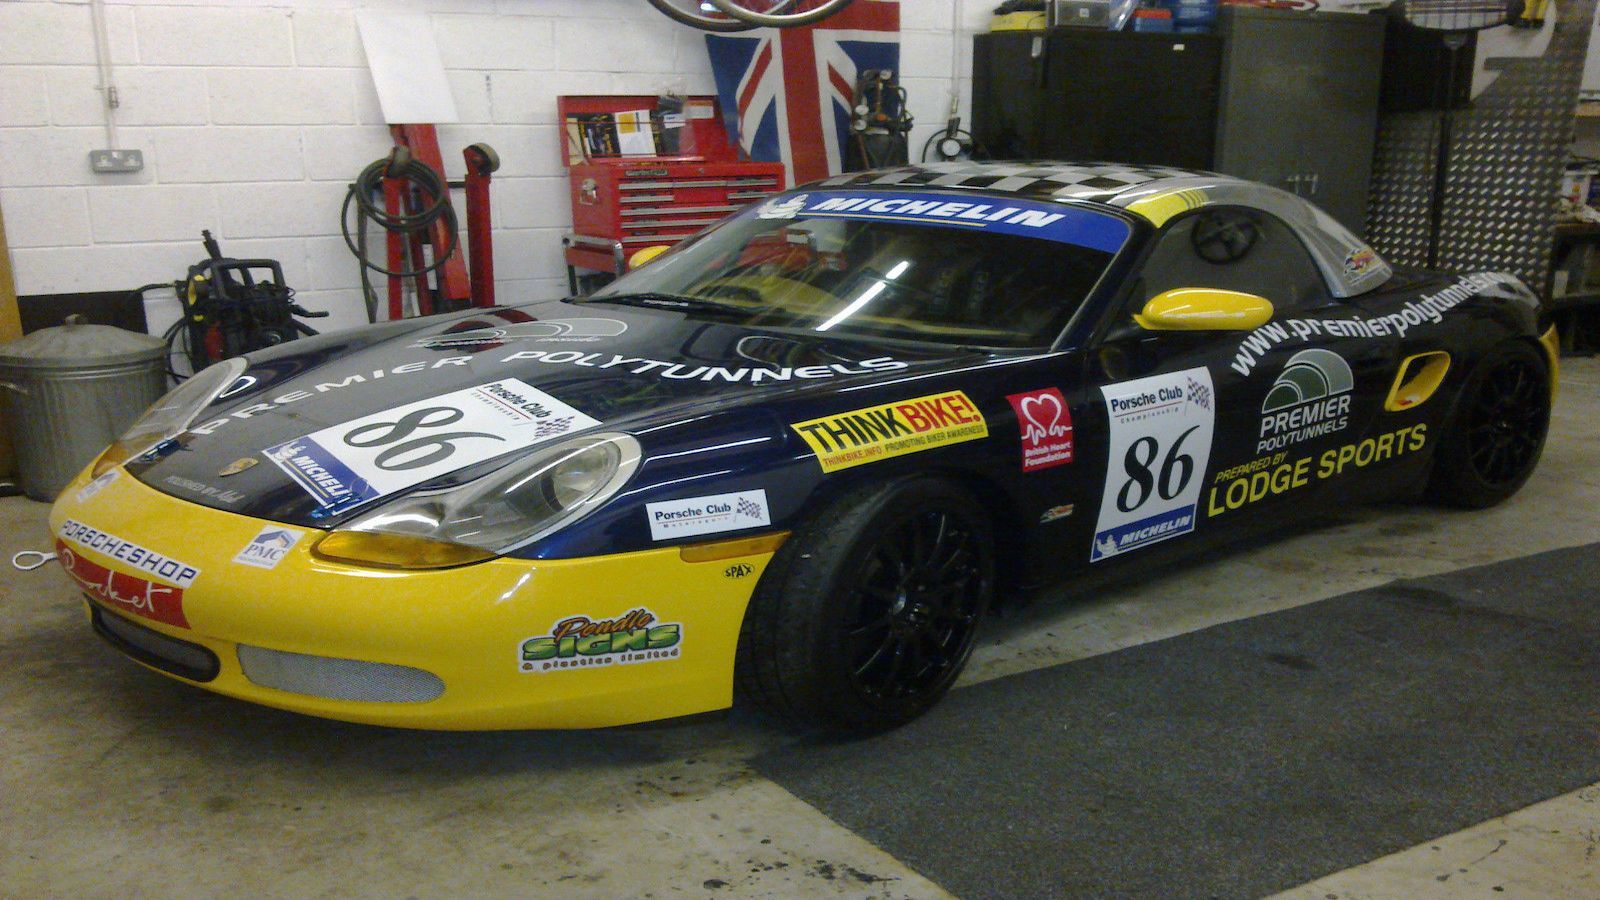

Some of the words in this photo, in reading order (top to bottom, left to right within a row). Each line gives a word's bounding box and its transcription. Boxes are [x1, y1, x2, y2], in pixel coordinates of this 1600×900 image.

[809, 198, 1067, 228] MICHELIN
[187, 355, 473, 436] PREMIER
[500, 351, 908, 383] POLYTUNNELS
[1111, 391, 1156, 412] Porsche
[1158, 386, 1183, 402] Club
[1259, 394, 1352, 438] PREMIER
[343, 406, 506, 471] 86
[1025, 445, 1049, 458] British
[1050, 441, 1071, 452] Heart
[1256, 416, 1348, 454] POLYTUNNELS
[1025, 451, 1071, 467] Foundation
[1116, 424, 1201, 513] 86
[1208, 456, 1312, 518] LODGE
[1317, 422, 1428, 480] SPORTS
[1213, 457, 1271, 484] PREPARED
[1271, 450, 1288, 466] BY
[655, 507, 702, 521] Porsche
[706, 502, 732, 514] Club
[1119, 515, 1192, 546] MICHELIN
[61, 519, 197, 582] PORSCHESHOP
[243, 544, 285, 561] PMC
[522, 624, 681, 661] SIGNS
